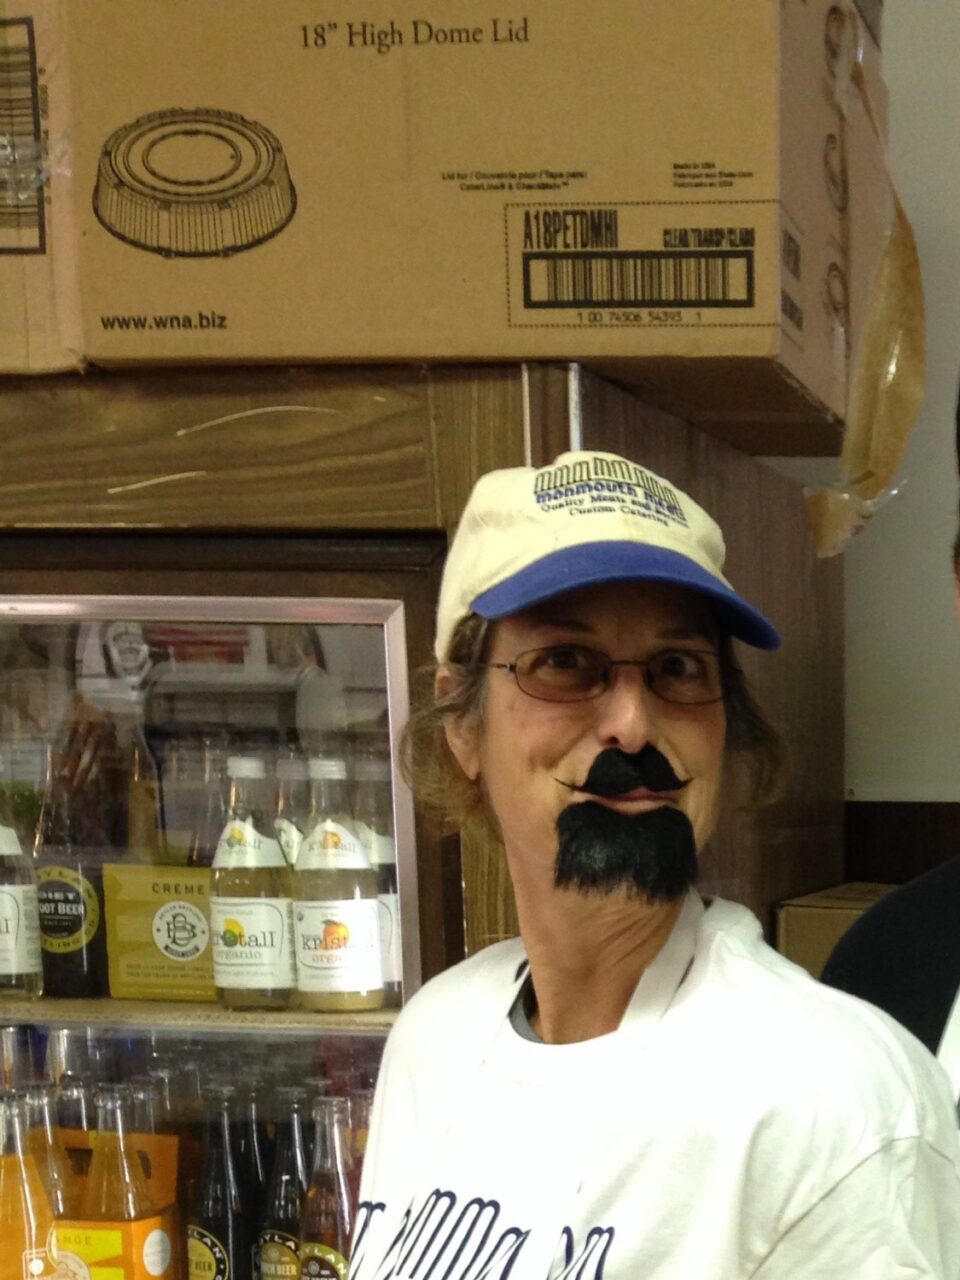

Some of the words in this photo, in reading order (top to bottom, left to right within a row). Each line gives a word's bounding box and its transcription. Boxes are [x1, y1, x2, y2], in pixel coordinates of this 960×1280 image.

[346, 20, 403, 55] High
[412, 19, 484, 46] Dome
[490, 17, 530, 43] Lid
[100, 311, 228, 331] www.wna.biz
[535, 480, 639, 504] monmouth
[151, 882, 205, 896] CREME
[39, 903, 56, 914] OOT
